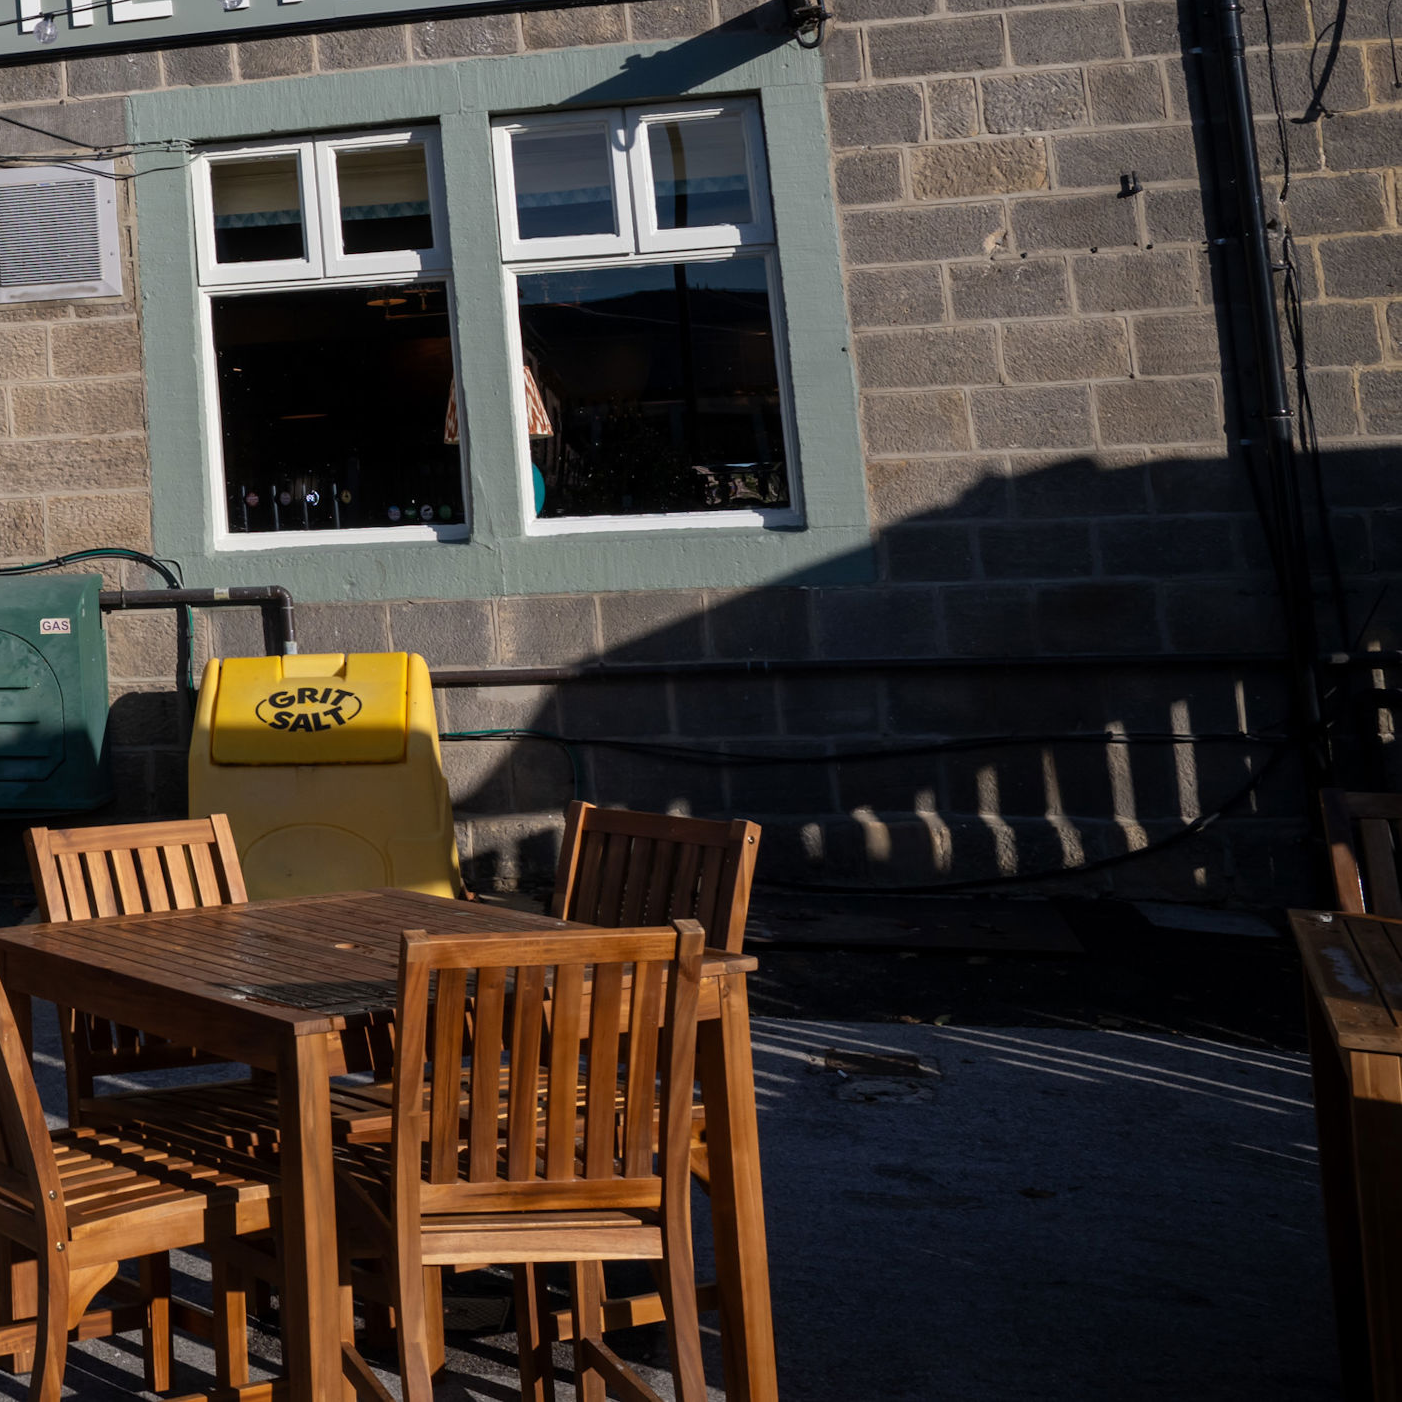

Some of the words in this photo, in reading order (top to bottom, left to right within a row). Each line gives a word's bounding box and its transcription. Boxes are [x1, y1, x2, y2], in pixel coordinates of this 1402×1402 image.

[42, 620, 70, 631] GAS
[268, 687, 354, 709] GRIT
[268, 706, 346, 733] SALT
